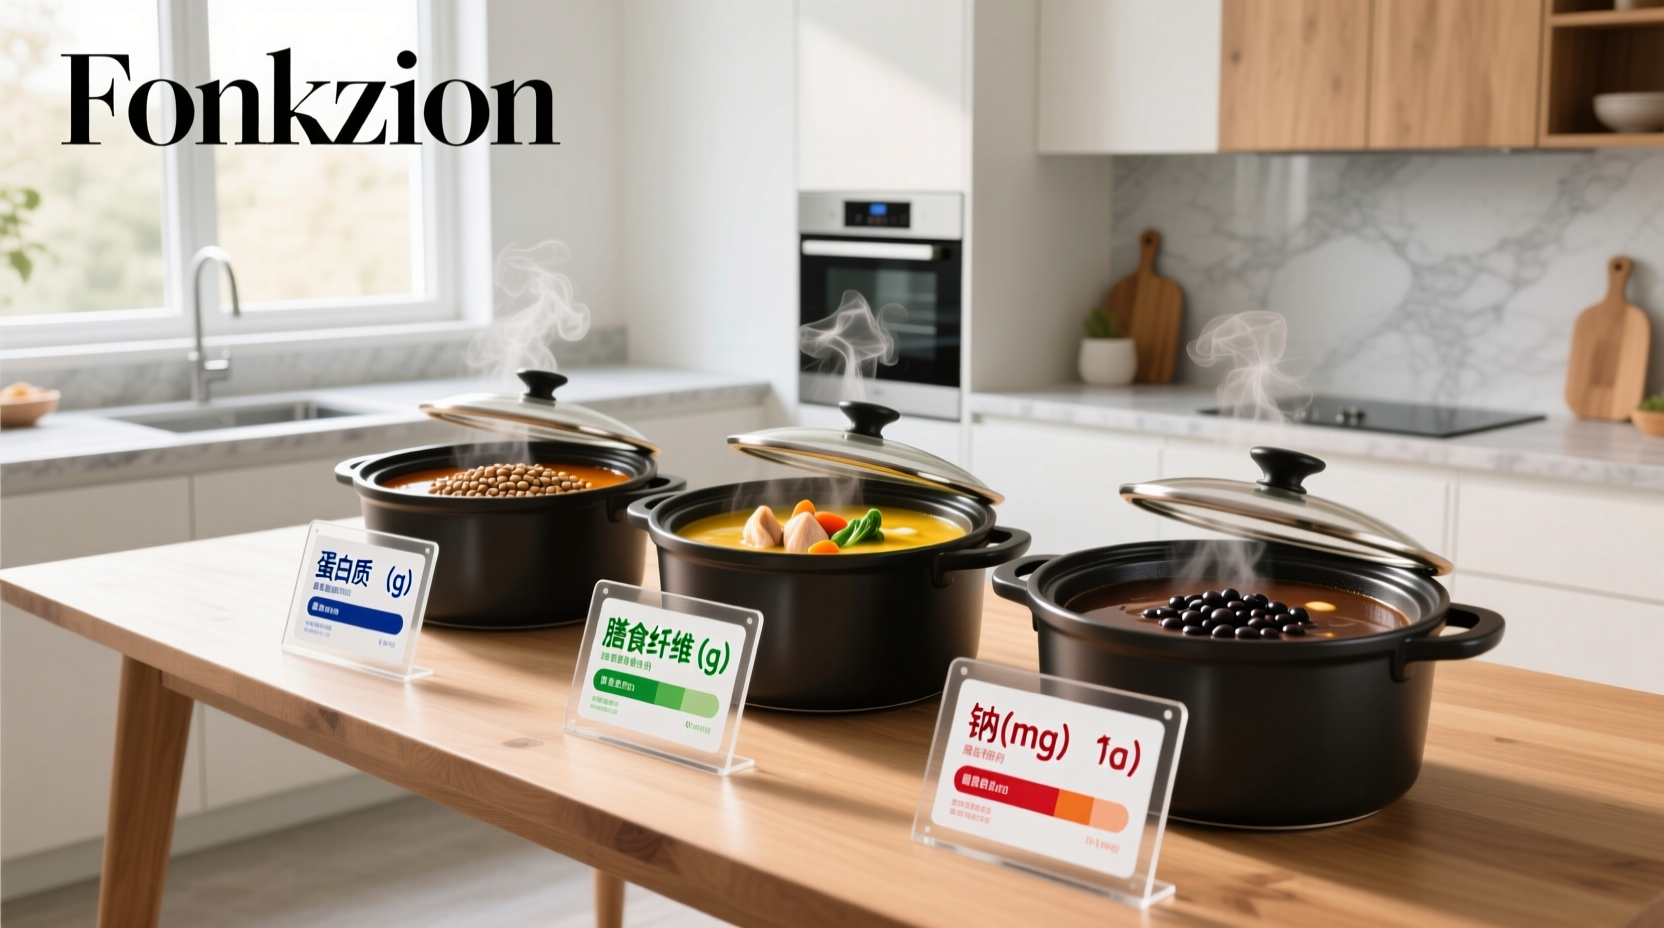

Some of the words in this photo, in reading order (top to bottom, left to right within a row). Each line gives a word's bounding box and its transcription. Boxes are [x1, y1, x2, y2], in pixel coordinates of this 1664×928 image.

[315, 550, 373, 588] 蛋白质
[386, 565, 413, 599] (g)
